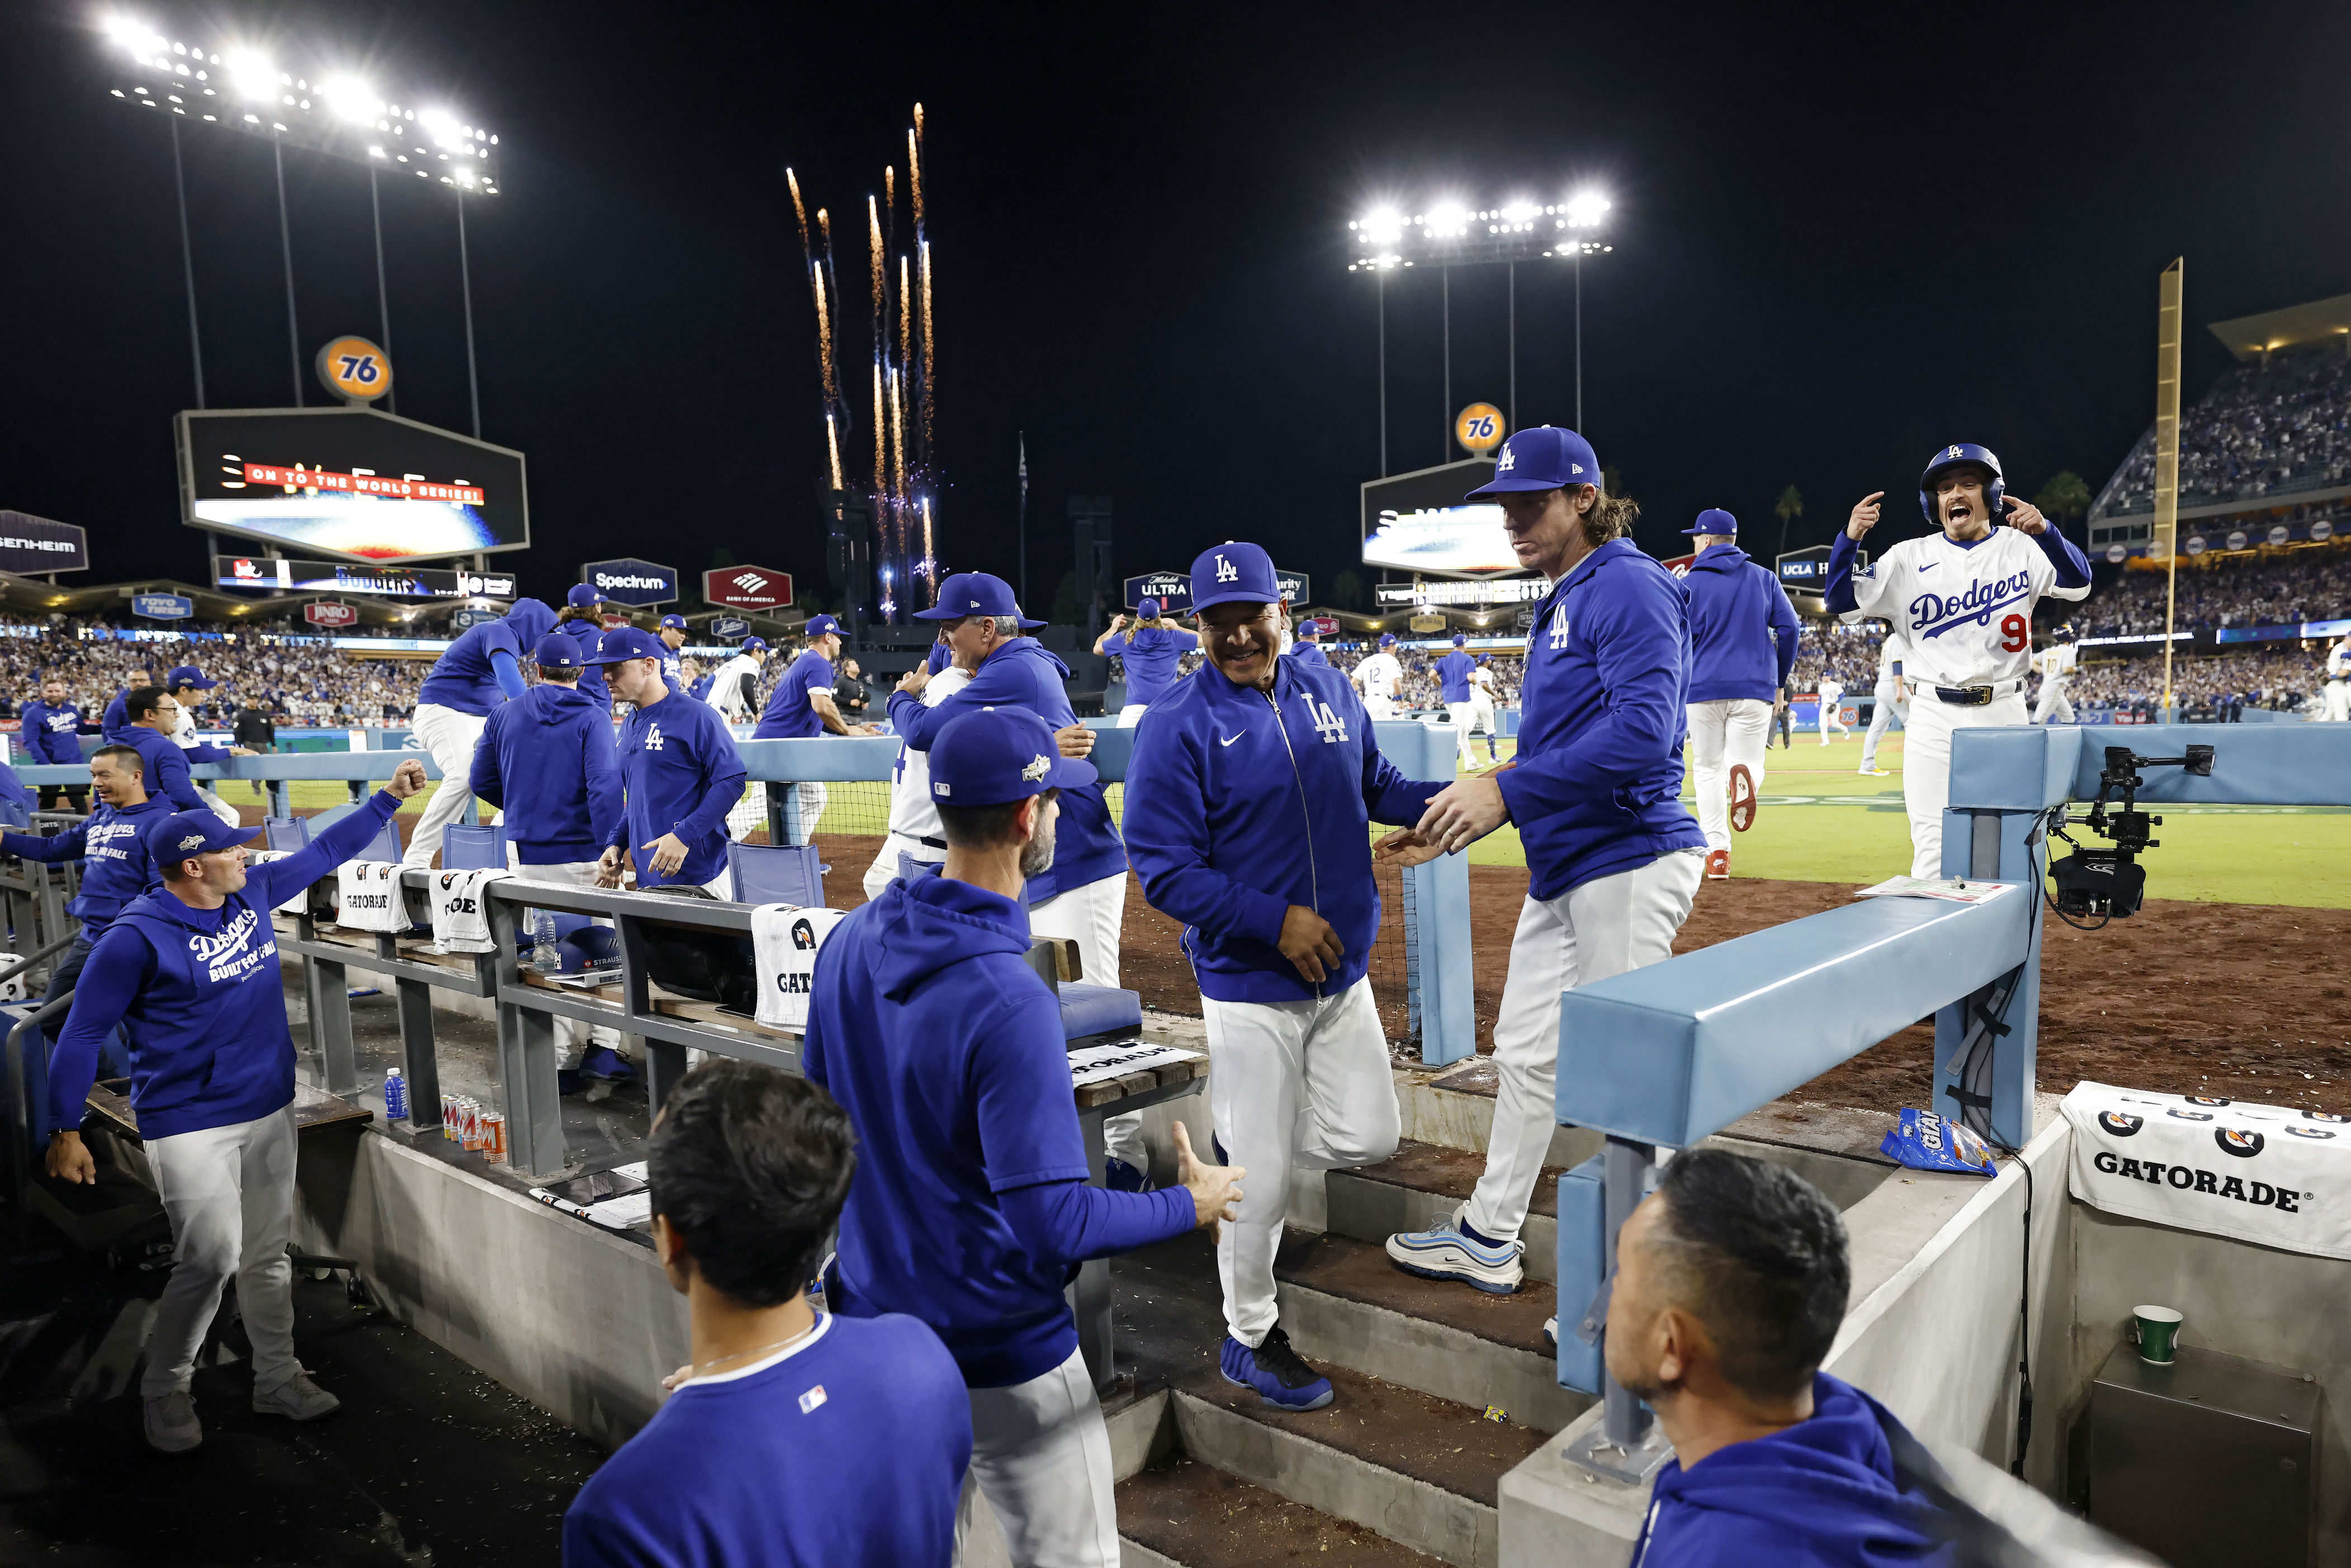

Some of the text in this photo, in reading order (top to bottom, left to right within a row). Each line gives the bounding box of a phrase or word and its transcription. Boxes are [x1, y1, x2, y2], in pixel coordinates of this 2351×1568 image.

[337, 353, 381, 385] 76
[1465, 414, 1496, 440] 76
[1499, 442, 1516, 472] LA
[1947, 444, 1964, 459] LA
[252, 468, 276, 481] ON
[286, 472, 308, 484] TO
[315, 475, 348, 489] THE
[355, 479, 411, 495] WORLD
[418, 485, 479, 501] SERIES!
[1214, 554, 1238, 583] LA
[1782, 565, 1813, 576] UCLA
[595, 572, 664, 590] Spectrum
[1142, 584, 1187, 596] ULTRA
[1148, 576, 1180, 584] Michelob
[1279, 578, 1302, 591] urity
[140, 597, 177, 607] TOYO
[1280, 589, 1297, 600] efit
[1909, 570, 2029, 632] Dodgers
[314, 605, 349, 620] JINRO
[1550, 595, 1569, 649] LA
[2001, 613, 2032, 652] 9
[1369, 667, 1381, 684] 12
[1300, 693, 1350, 743] LA
[1841, 710, 1857, 722] 76
[645, 723, 664, 750] LA
[106, 847, 128, 860] FALL
[208, 958, 242, 983] BUILT
[593, 955, 622, 966] STRAUSS
[777, 973, 811, 993] GAT
[1071, 1046, 1177, 1074] TORADE
[2094, 1152, 2300, 1213] GATORADE
